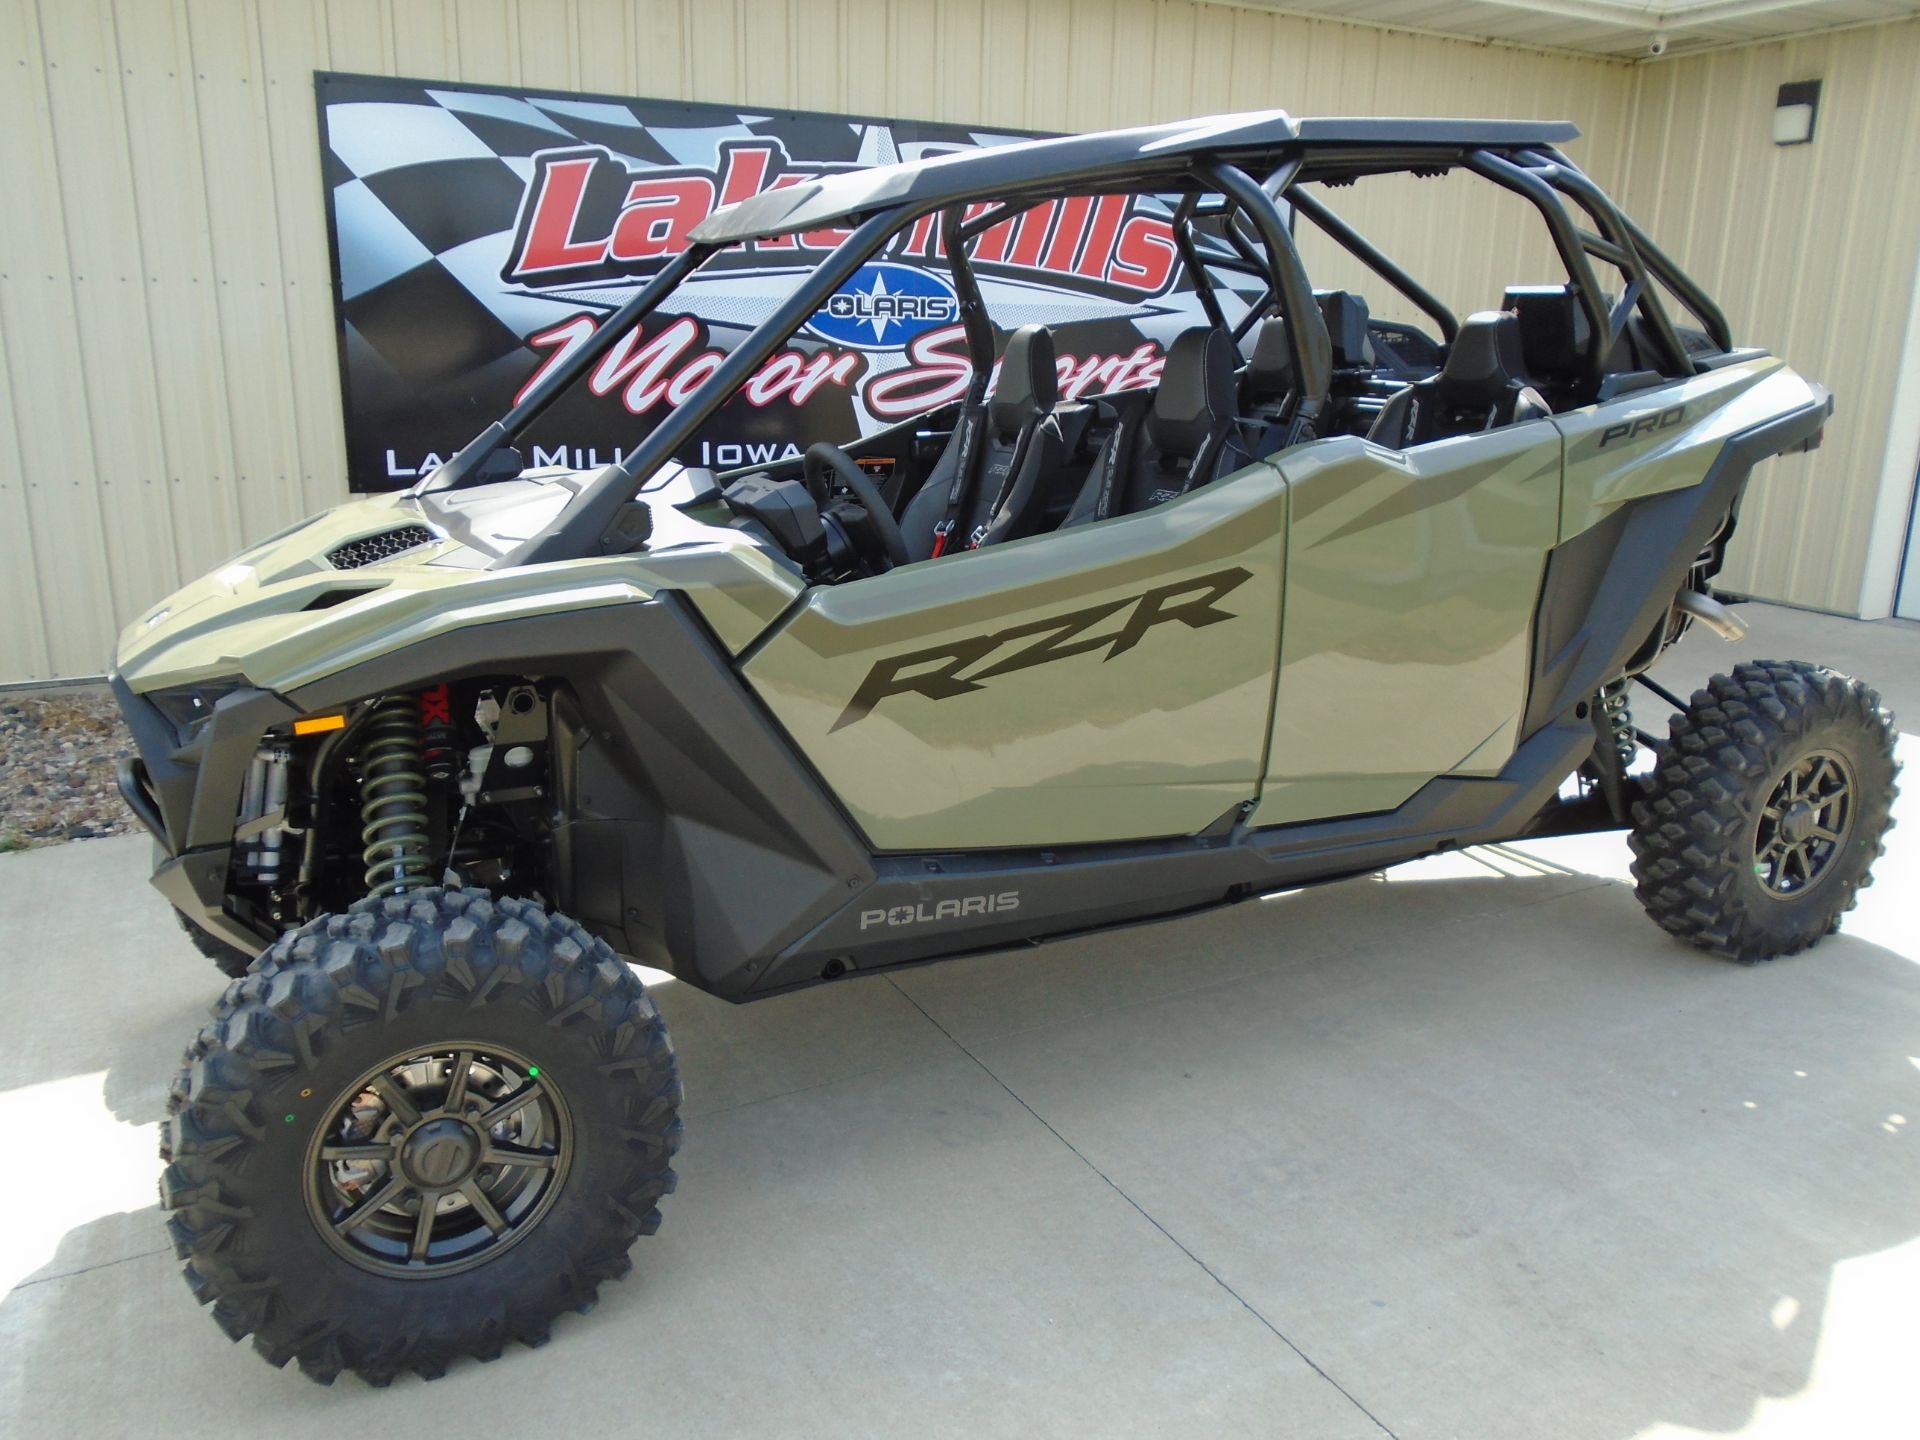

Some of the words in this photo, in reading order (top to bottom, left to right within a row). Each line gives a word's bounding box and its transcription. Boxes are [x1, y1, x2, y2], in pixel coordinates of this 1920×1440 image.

[512, 146, 860, 277] Lak
[513, 316, 858, 414] Moor
[866, 323, 1167, 415] Sorts
[386, 448, 460, 476] LA
[532, 444, 625, 470] MILL
[1599, 405, 1685, 448] PRO
[827, 566, 1254, 735] RZR
[860, 891, 1021, 930] POLARIS
